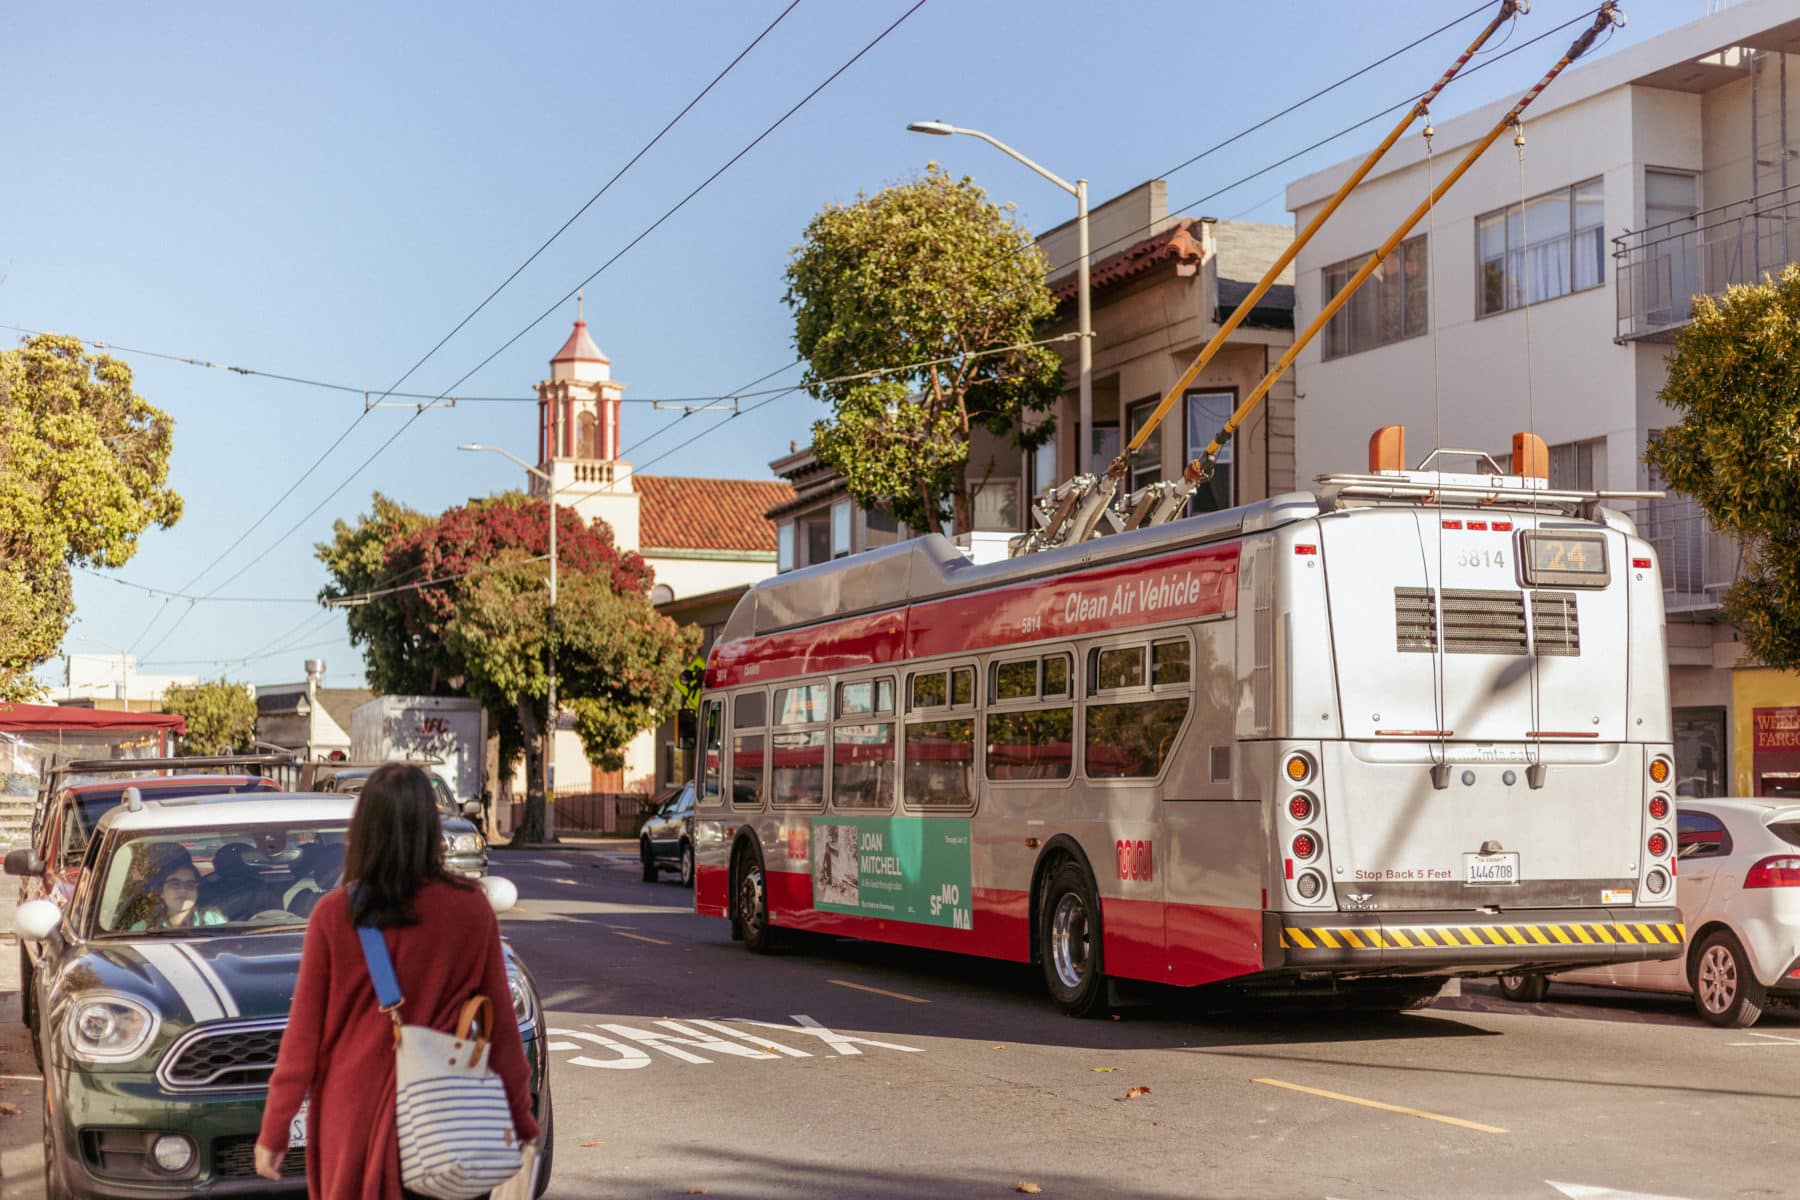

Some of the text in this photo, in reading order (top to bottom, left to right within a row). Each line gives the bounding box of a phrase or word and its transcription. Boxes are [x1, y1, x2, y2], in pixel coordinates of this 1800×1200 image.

[1546, 540, 1586, 571] 24
[1064, 571, 1200, 624] Clean Air Vehicle
[1022, 616, 1041, 633] 5814
[860, 833, 882, 851] JOAN
[861, 855, 902, 876] MITCHELL
[1355, 869, 1452, 881] Stop Back 5 Feet
[1470, 865, 1512, 880] 1446708
[930, 894, 942, 915] SF
[942, 883, 959, 905] MO
[953, 908, 970, 930] MA
